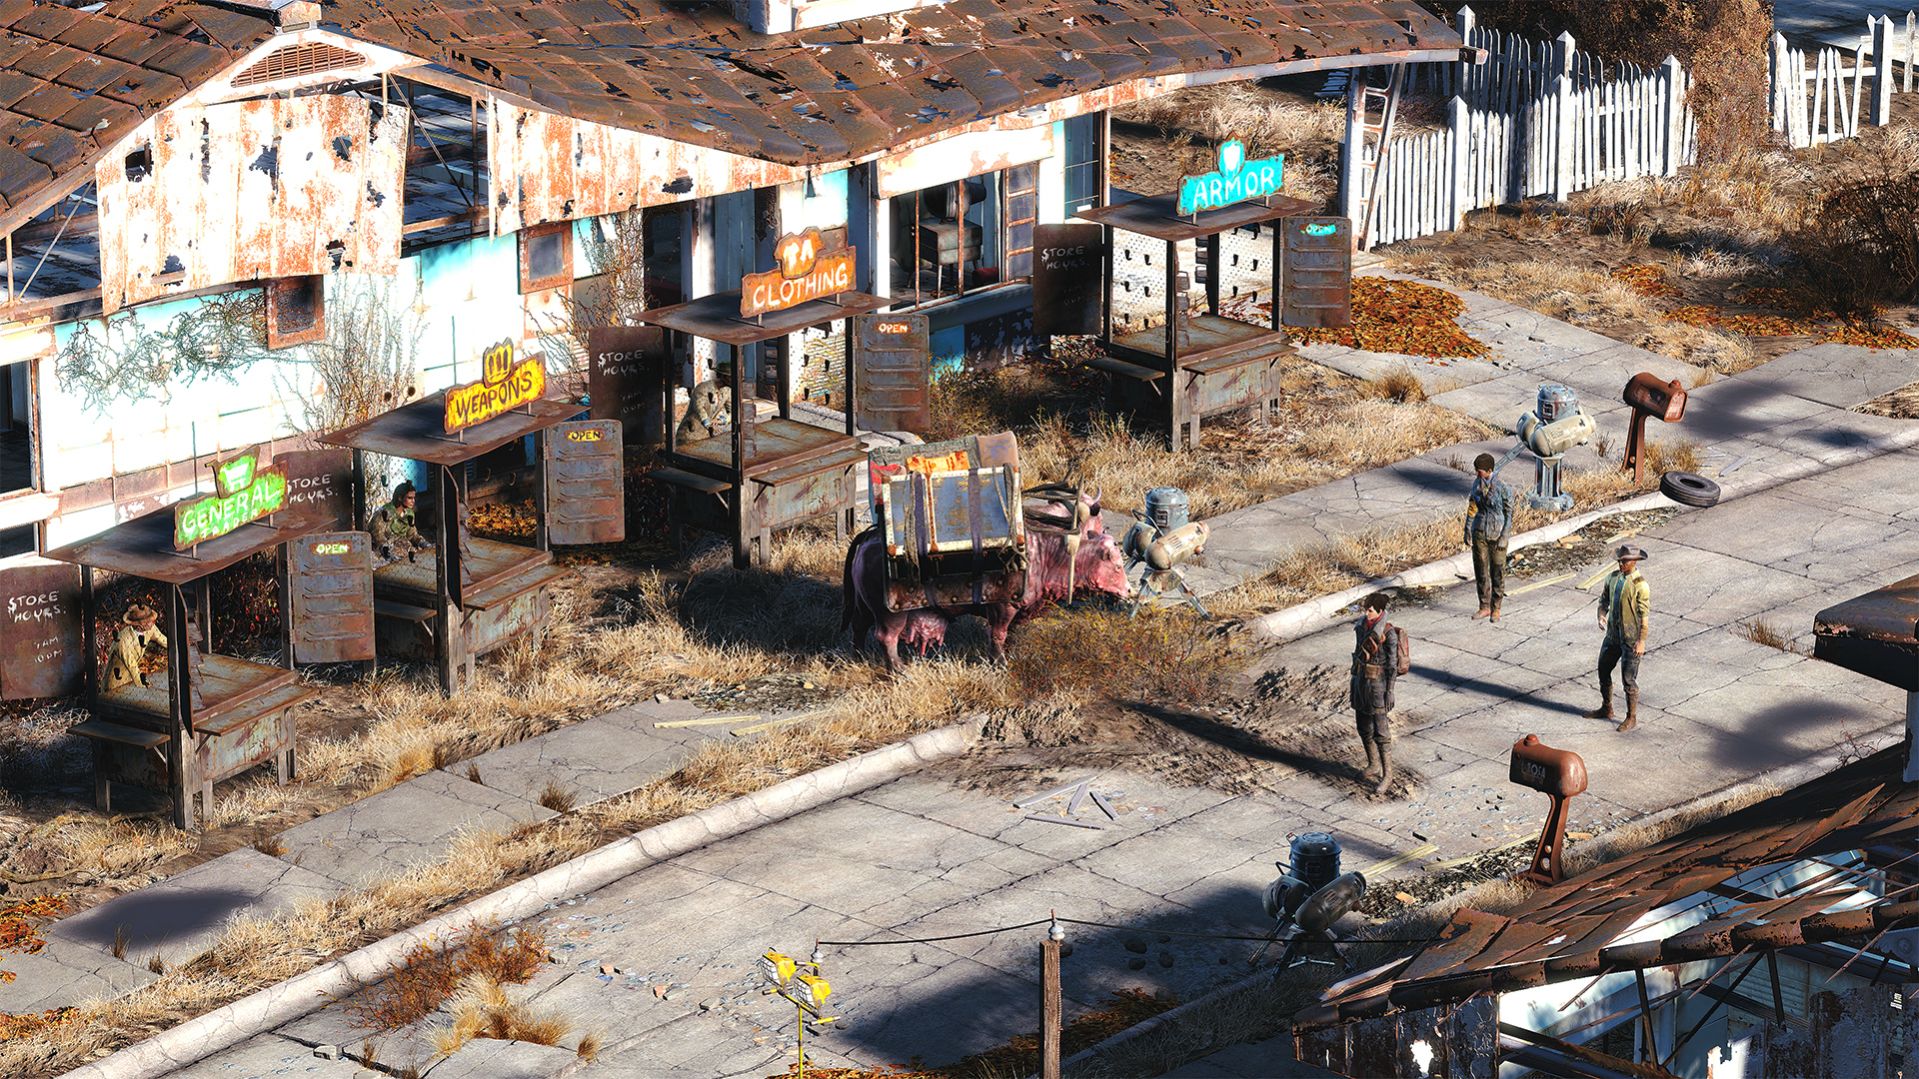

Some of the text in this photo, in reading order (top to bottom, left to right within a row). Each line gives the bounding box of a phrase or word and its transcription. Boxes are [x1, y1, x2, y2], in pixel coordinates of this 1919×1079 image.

[1193, 167, 1275, 208] ARMOR
[1041, 246, 1085, 262] STORE
[753, 262, 848, 307] CLOTHING
[878, 322, 908, 334] OPEN
[598, 350, 645, 369] STORE
[456, 370, 533, 420] WEAPONS
[571, 431, 601, 441] OPEN
[182, 480, 281, 534] GENERAL
[316, 543, 350, 555] OPEN
[8, 590, 59, 616] STORE
